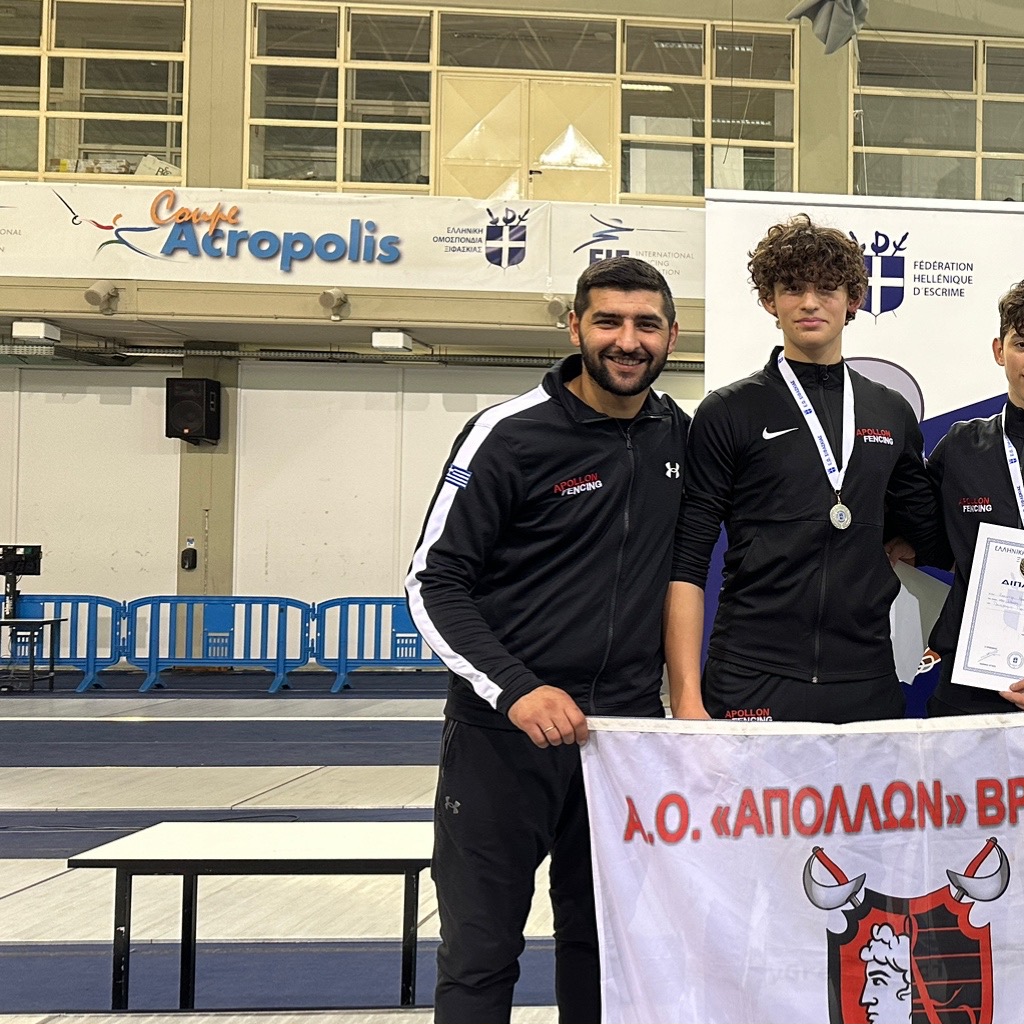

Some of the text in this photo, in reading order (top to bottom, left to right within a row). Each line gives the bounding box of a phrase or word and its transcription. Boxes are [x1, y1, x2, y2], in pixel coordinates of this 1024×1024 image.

[150, 190, 239, 236] Coupe
[447, 226, 484, 235] ΕΛΛΗΝΙΚΗ
[432, 235, 483, 244] ΟΜΟΣΠΟΝΔΙΑ
[160, 219, 402, 272] Acropolis
[444, 244, 483, 253] ΞΙΦΑΣΚΙΑΣ
[635, 250, 695, 260] INTERNATIONAL
[914, 260, 974, 272] FÉDÉRATION
[913, 272, 974, 285] HELLÉNIQUE
[856, 428, 892, 437] APOLLON
[863, 435, 894, 445] FENCING
[553, 472, 599, 494] APOLLON
[561, 480, 603, 496] FENCING
[963, 504, 992, 513] FENCING
[725, 708, 770, 718] APOLLON
[624, 792, 700, 845] Α.Ο.
[711, 780, 966, 837] «ΑΠΟΛΛΩΝ»
